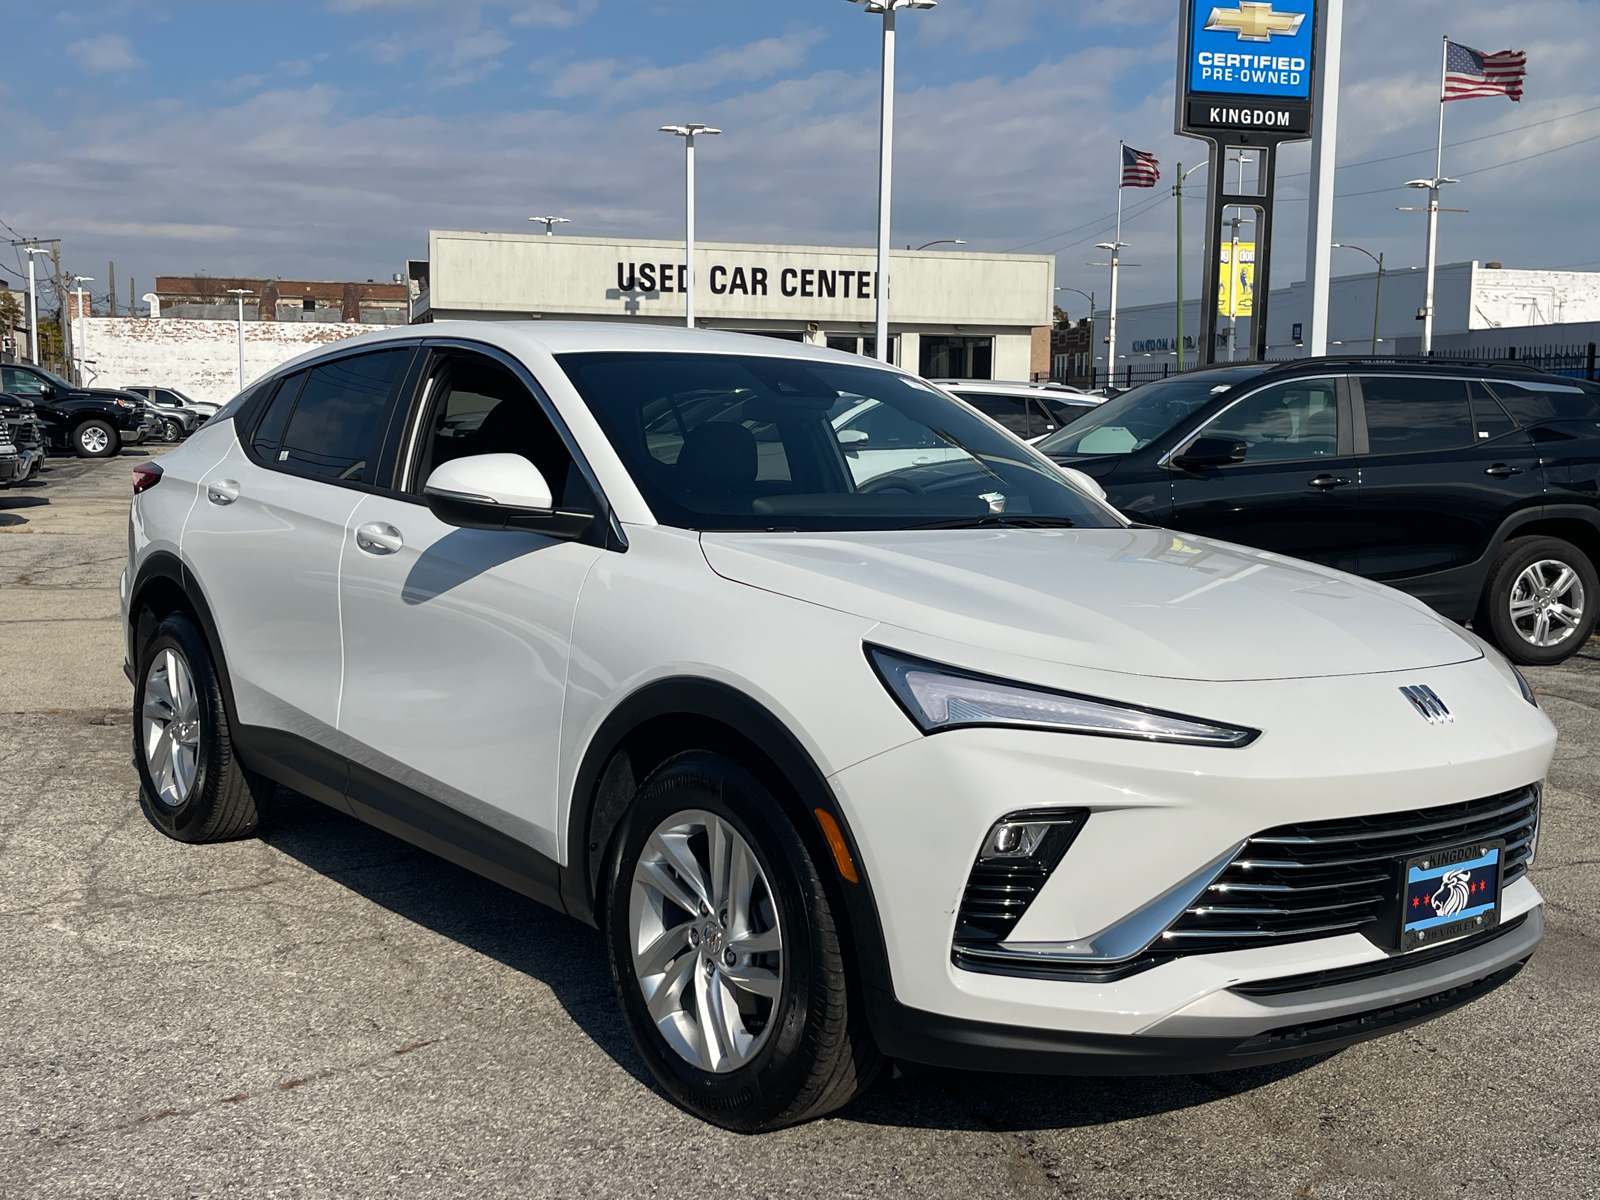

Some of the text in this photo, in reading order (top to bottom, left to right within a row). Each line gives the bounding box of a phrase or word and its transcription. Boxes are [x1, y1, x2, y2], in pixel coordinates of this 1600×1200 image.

[1198, 52, 1305, 71] CERTIFIED
[1202, 68, 1300, 85] PRE-OWNED
[1210, 107, 1290, 126] KINGDOM
[710, 265, 768, 296] CAR
[1132, 338, 1168, 352] KINGDOM
[1430, 845, 1481, 867] KINGDOM
